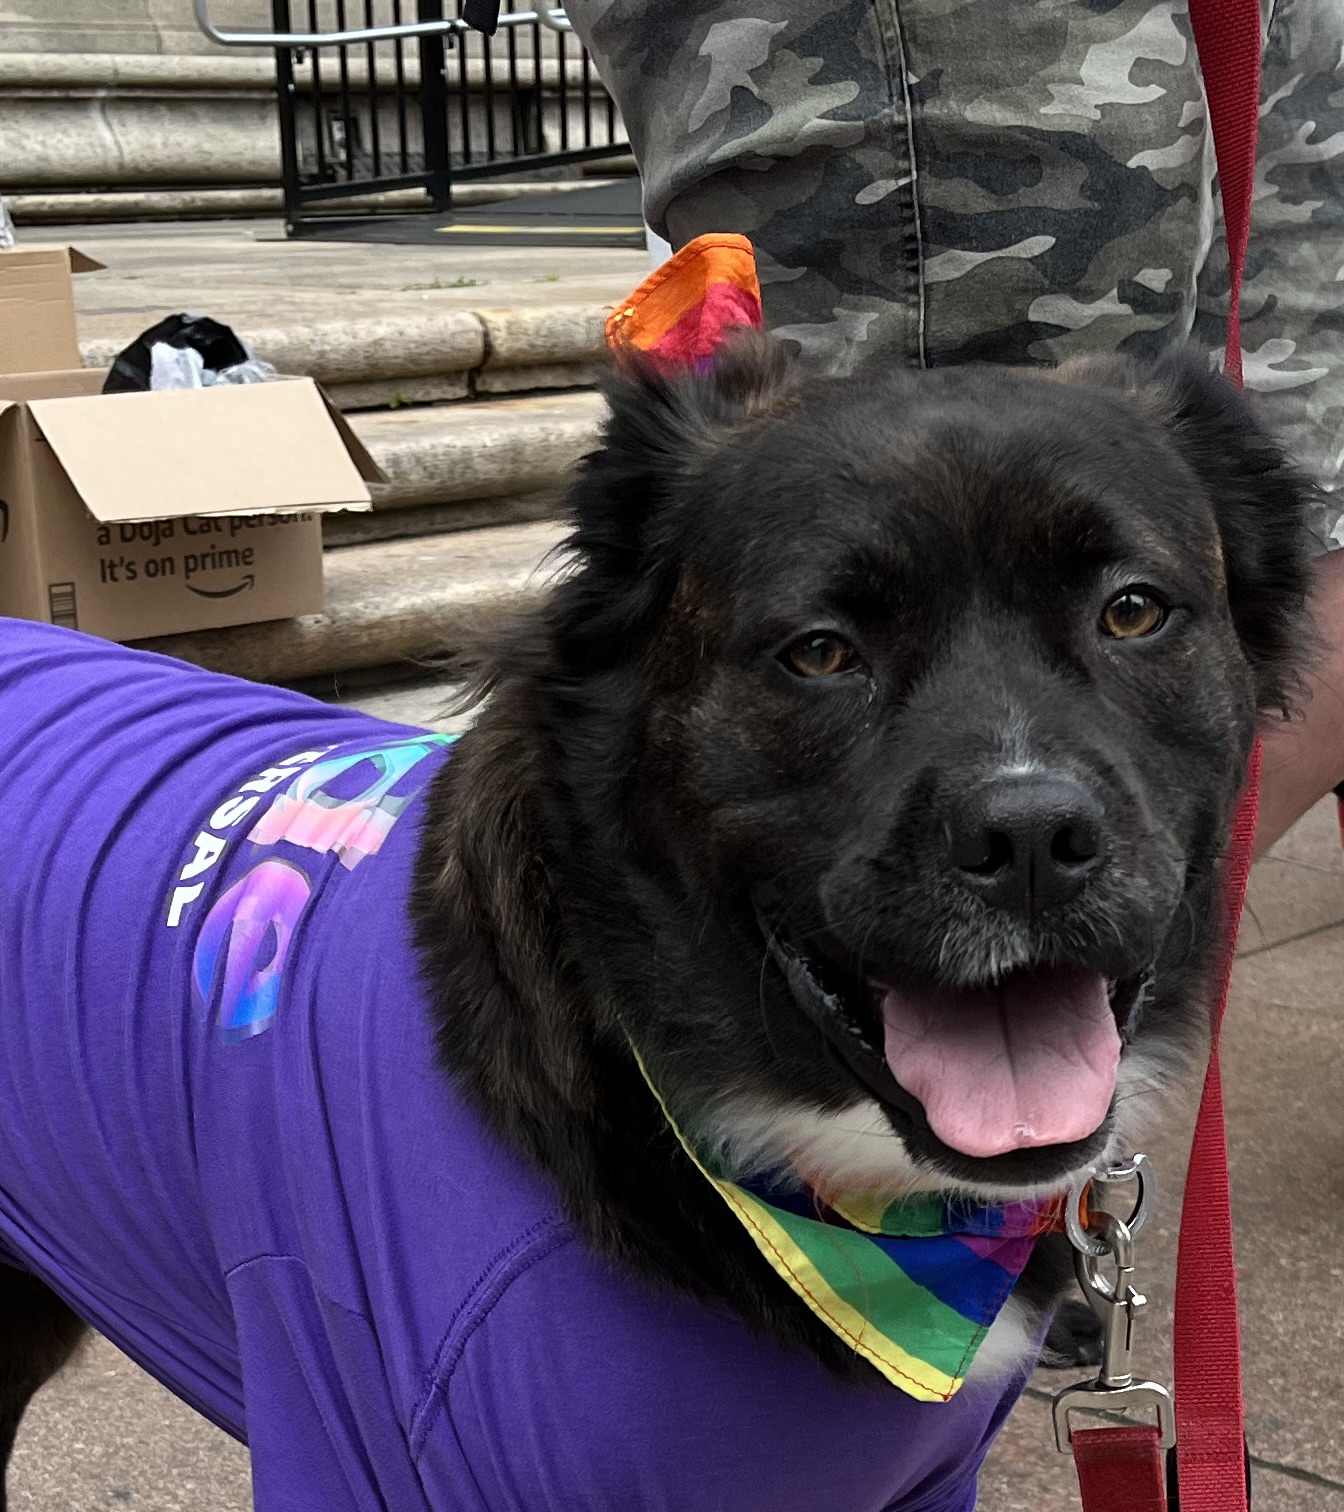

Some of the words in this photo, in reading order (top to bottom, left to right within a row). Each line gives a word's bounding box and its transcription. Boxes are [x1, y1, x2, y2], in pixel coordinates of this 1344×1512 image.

[99, 556, 138, 584] It's
[144, 556, 176, 579] on
[184, 544, 255, 580] prime
